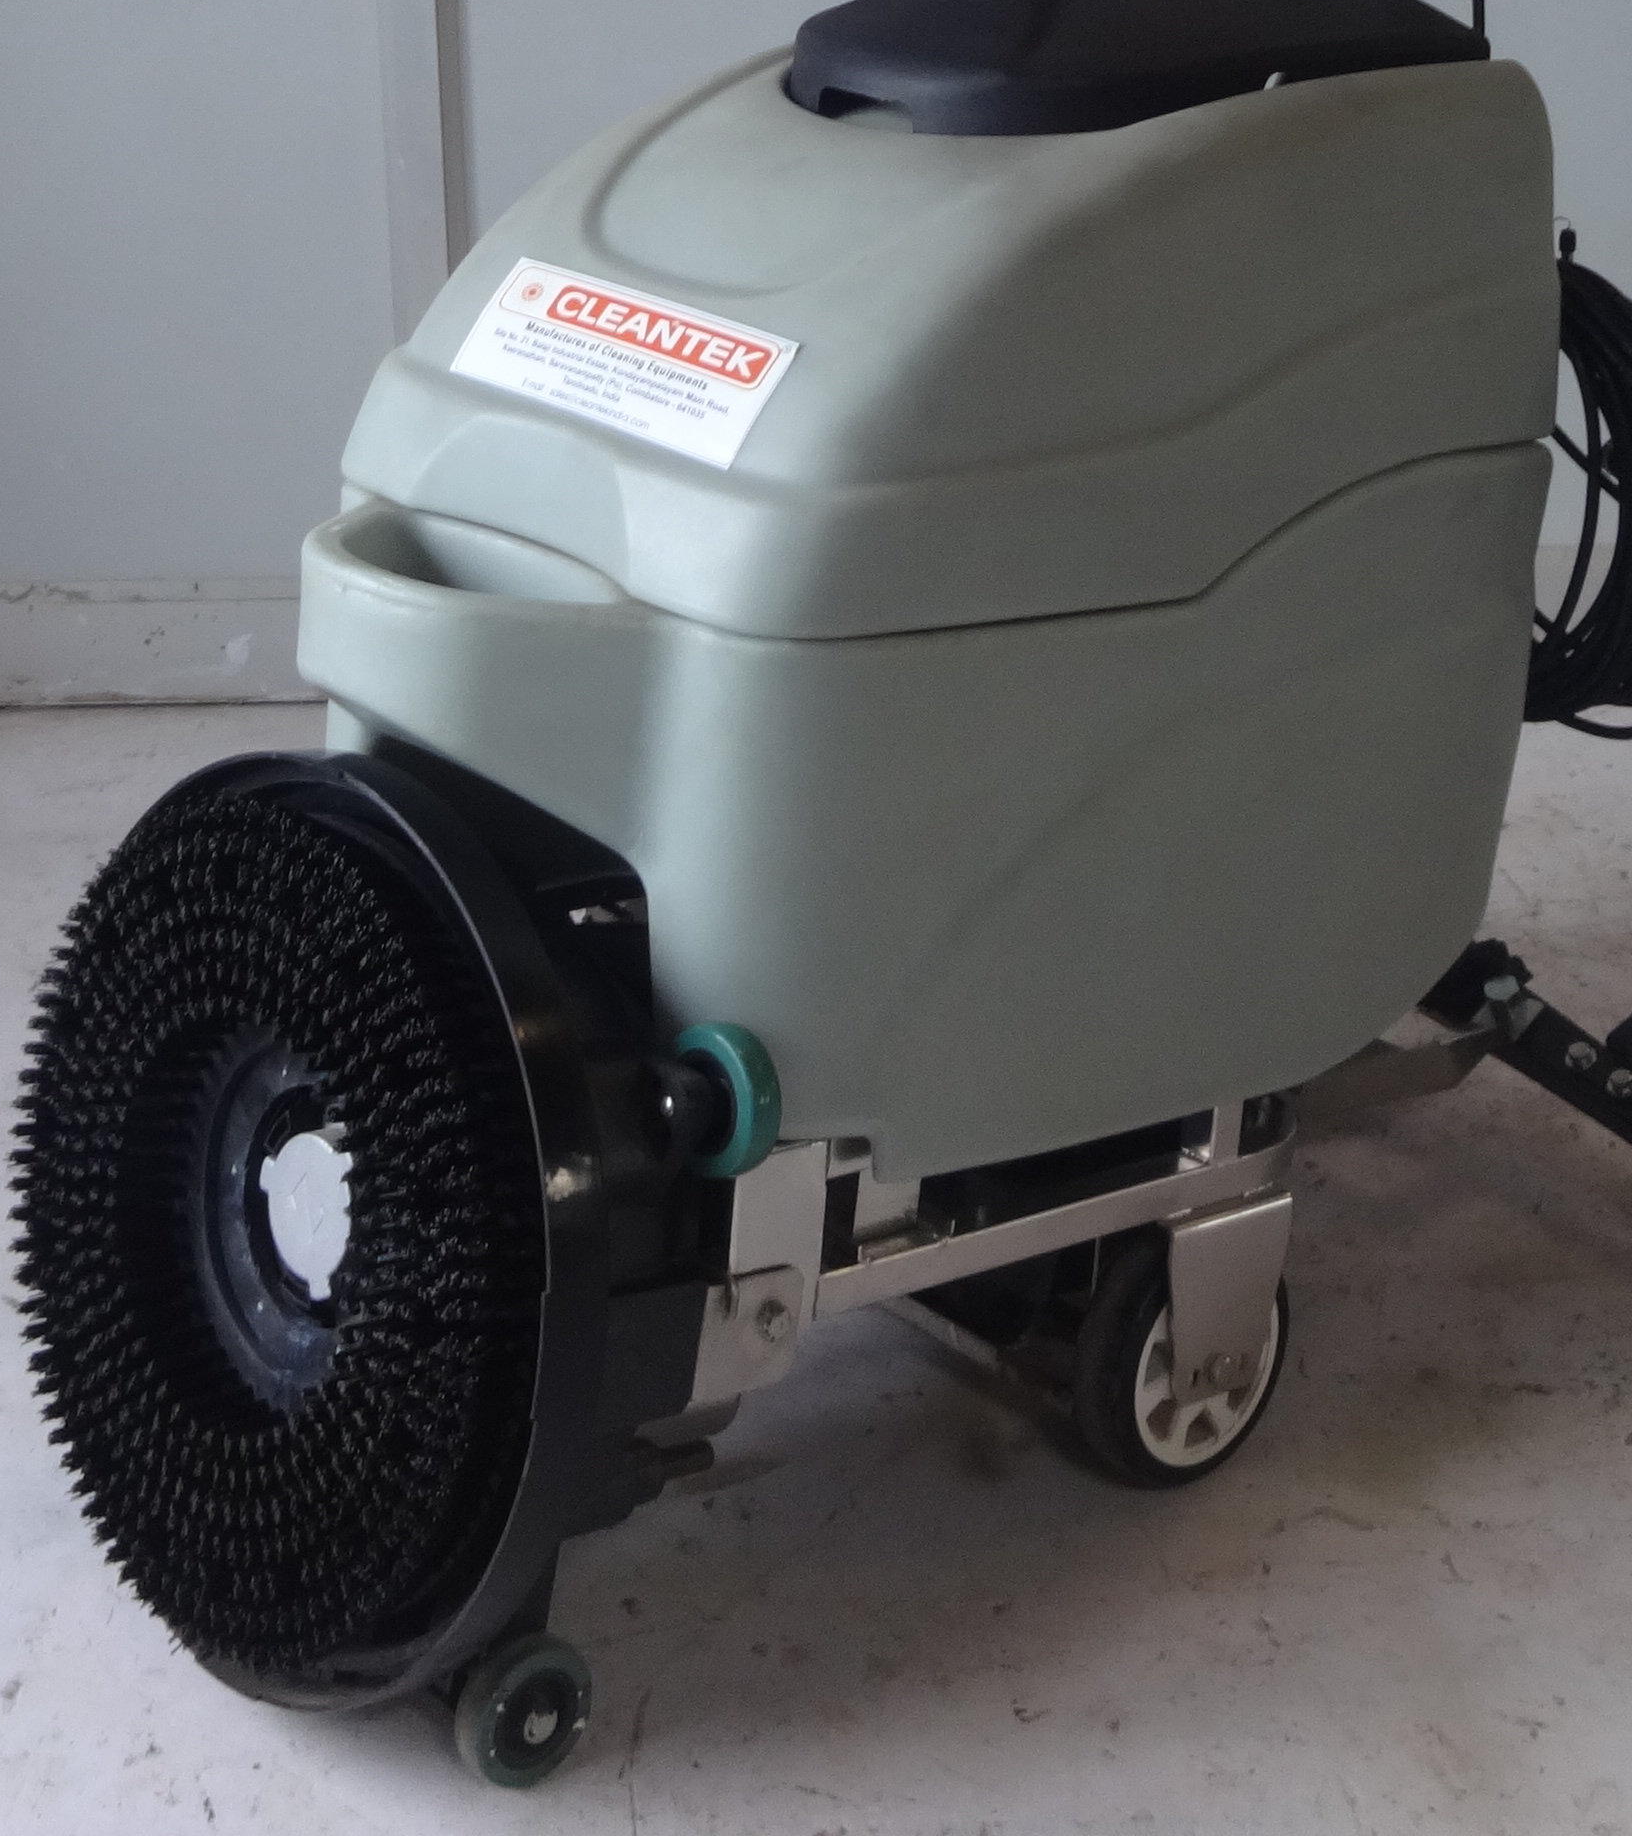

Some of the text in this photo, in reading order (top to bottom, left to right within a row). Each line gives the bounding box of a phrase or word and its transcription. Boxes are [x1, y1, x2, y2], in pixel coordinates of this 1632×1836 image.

[525, 320, 709, 391] Manufactures of Cleaning Equipments
[556, 291, 766, 378] CLEANTEK
